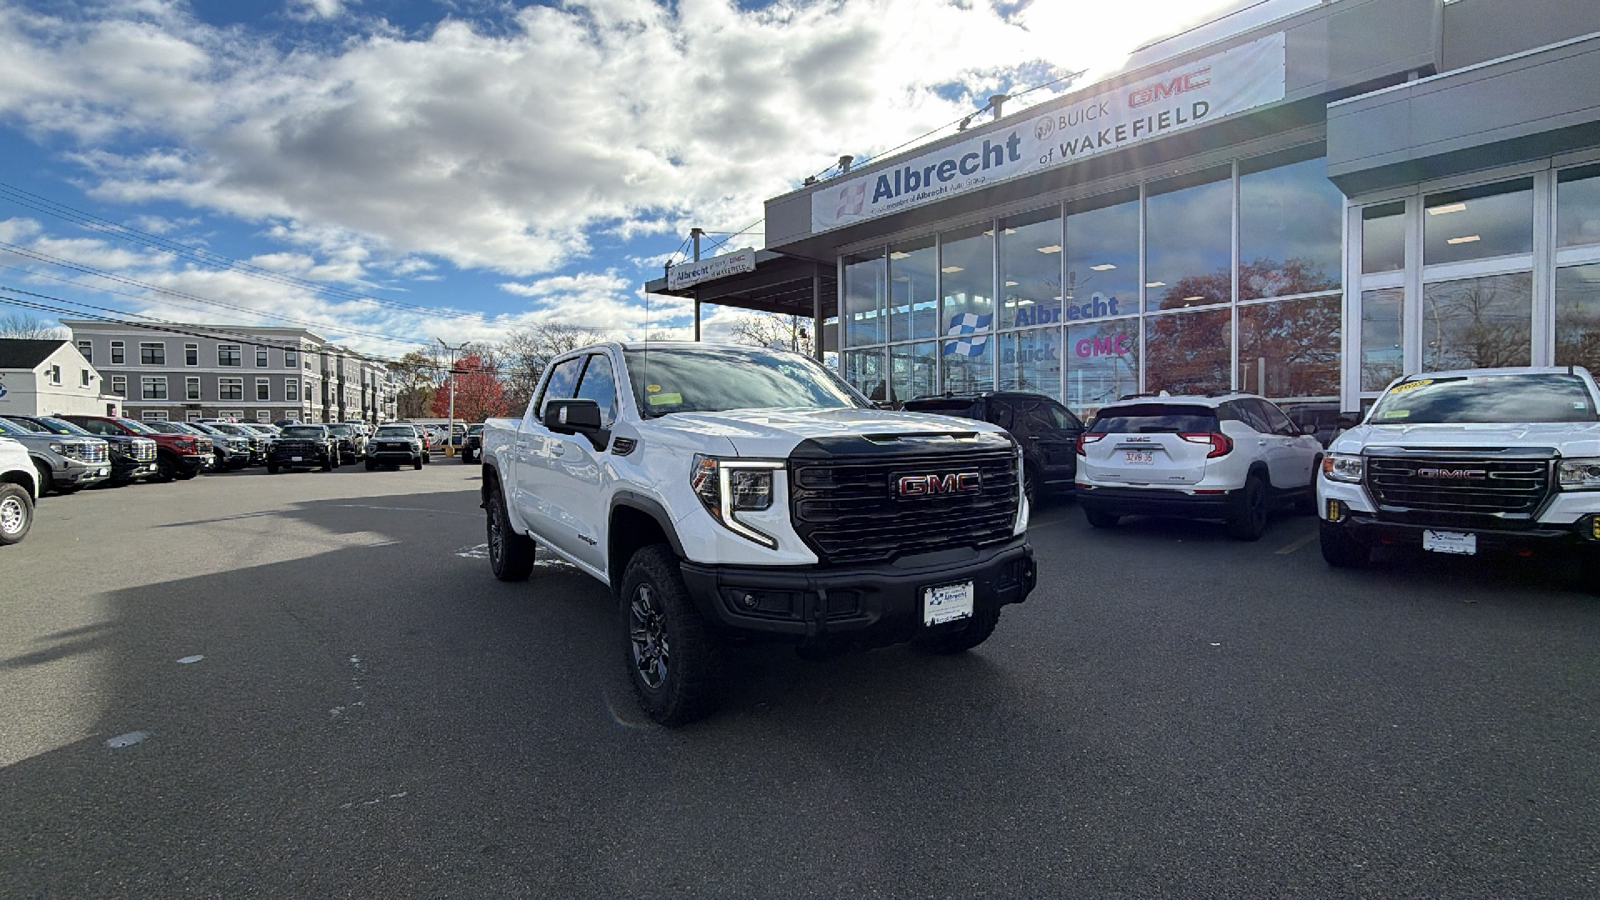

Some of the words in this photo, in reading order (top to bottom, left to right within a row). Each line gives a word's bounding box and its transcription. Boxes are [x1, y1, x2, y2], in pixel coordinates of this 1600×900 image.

[1058, 101, 1109, 130] BUICK
[1128, 66, 1211, 109] GMC
[1039, 147, 1053, 164] of
[1059, 101, 1210, 157] WAKEFIELD
[871, 131, 1021, 204] Albrecht
[916, 186, 948, 201] Albrecht
[677, 266, 709, 281] Albrecht
[716, 264, 747, 276] WAKEFIELD
[1014, 295, 1119, 328] Albrecht
[1004, 343, 1057, 363] Buick
[1075, 334, 1130, 359] GMC
[898, 472, 979, 497] GMC
[1418, 467, 1486, 480] GMC
